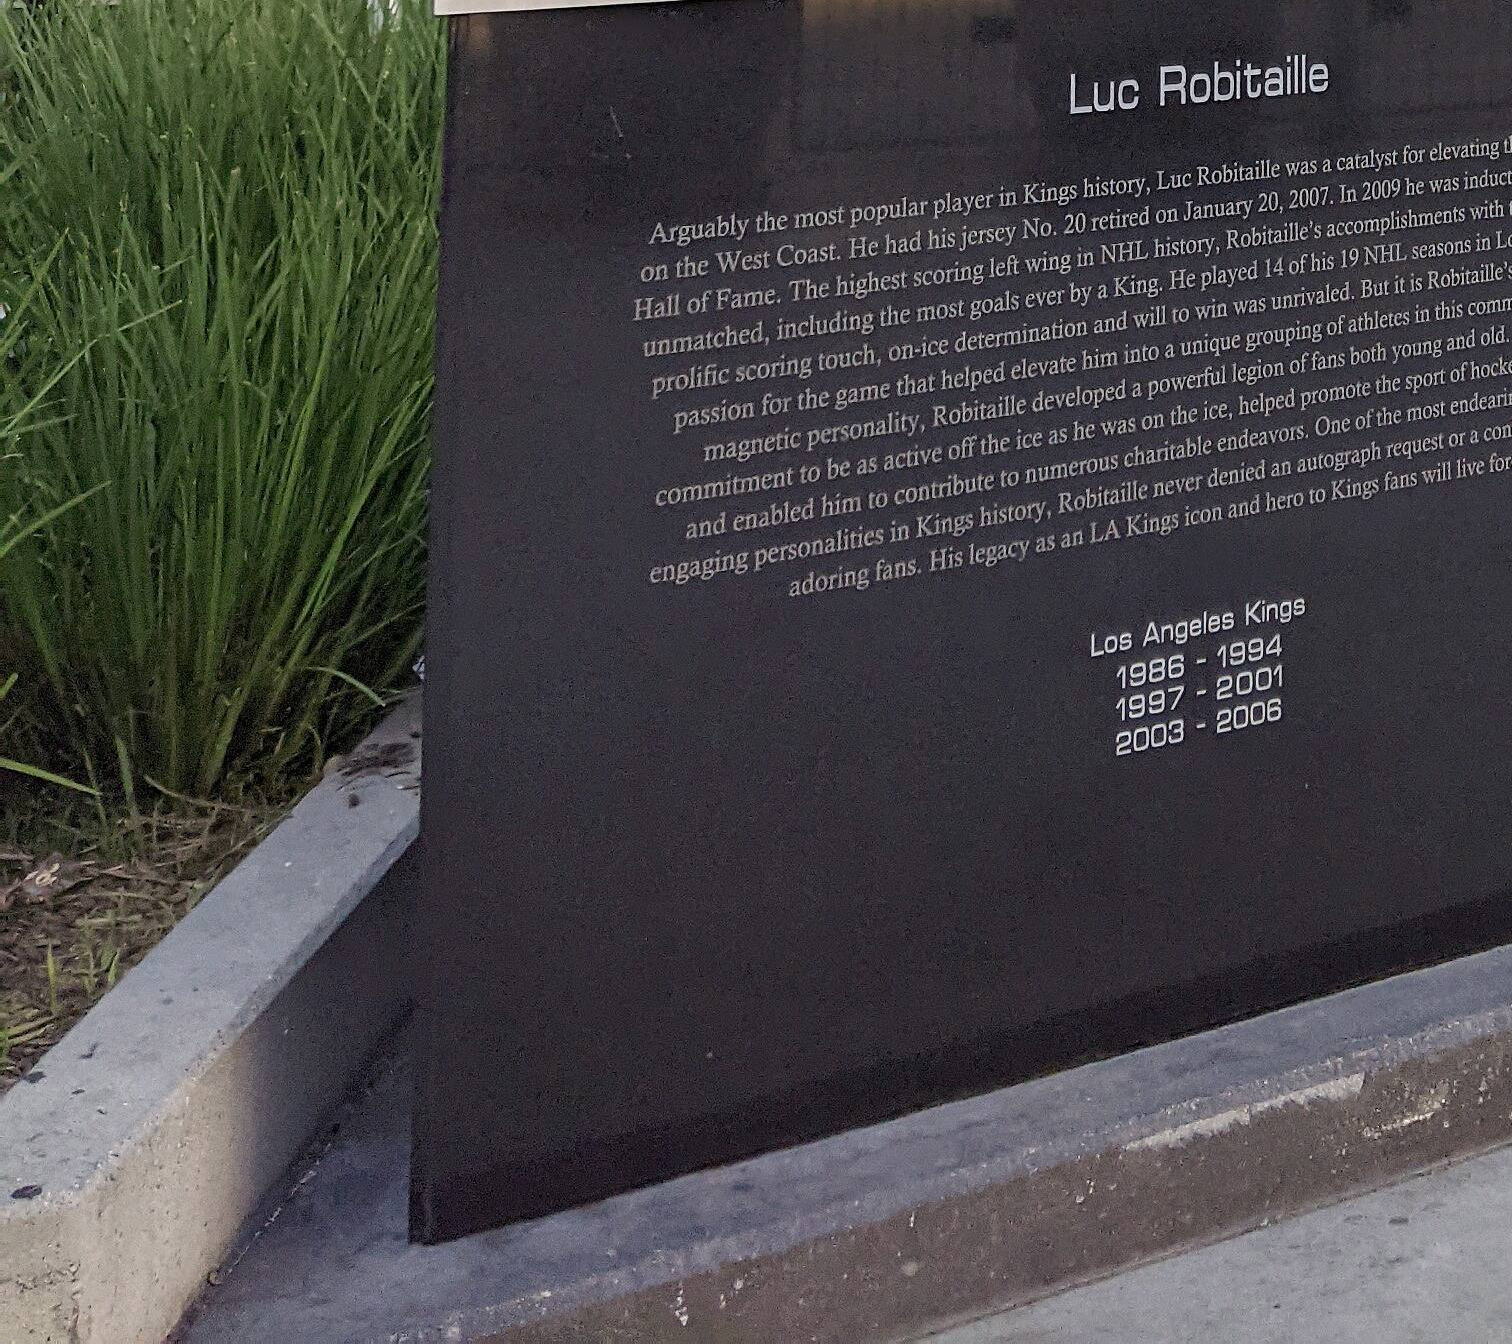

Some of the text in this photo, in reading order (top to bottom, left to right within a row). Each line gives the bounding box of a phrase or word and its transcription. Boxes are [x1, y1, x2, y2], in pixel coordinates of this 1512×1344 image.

[1071, 55, 1328, 114] Luc Robitaille
[648, 211, 750, 247] Arguably
[755, 210, 789, 233] the
[793, 205, 845, 229] most
[849, 196, 929, 229] popular
[932, 191, 994, 220] player
[998, 185, 1018, 207] in
[1022, 182, 1078, 206] Kings
[1082, 175, 1151, 198] history,
[1155, 169, 1193, 191] Luc
[1196, 158, 1281, 186] Robitaille
[1284, 159, 1318, 177] was
[1322, 158, 1333, 173] a
[1336, 148, 1399, 173] catalyst
[1401, 144, 1426, 165] for
[1429, 137, 1500, 162] elevating
[632, 292, 681, 322] Hall
[686, 289, 713, 315] of
[715, 287, 782, 311] Fame.
[788, 278, 830, 302] The
[834, 270, 909, 300] highest
[913, 260, 985, 288] scoring
[988, 254, 1020, 278] left
[1024, 250, 1072, 275] wing
[1076, 246, 1095, 268] in
[1100, 239, 1149, 265] NHL
[1153, 236, 1220, 259] history,
[1225, 219, 1322, 250] Robitaille's
[1326, 206, 1466, 238] accomplishments
[1469, 198, 1505, 221] with
[651, 363, 730, 400] prolific
[735, 353, 813, 383] scoring
[818, 342, 882, 371] touch,
[888, 335, 949, 362] on-ice
[954, 318, 1088, 353] determination
[1093, 309, 1129, 334] and
[1132, 304, 1167, 329] will
[1171, 307, 1190, 324] to
[1194, 297, 1228, 321] win
[1232, 297, 1267, 316] was
[1270, 281, 1355, 311] unrivaled.
[1360, 278, 1390, 299] But
[1393, 274, 1406, 294] it
[1410, 272, 1423, 293] is
[649, 549, 750, 585] engaging
[753, 525, 885, 572] personalities
[889, 519, 910, 543] in
[915, 512, 974, 539] Kings
[978, 501, 1052, 527] history,
[1057, 479, 1149, 515] Robitaille
[1152, 475, 1204, 498] never
[1207, 458, 1266, 488] denied
[1270, 460, 1292, 478] an
[1296, 440, 1382, 473] autograph
[1385, 432, 1445, 460] request
[1448, 431, 1466, 448] or
[1469, 429, 1480, 444] a
[685, 511, 727, 540] and
[732, 497, 815, 532] enabled
[821, 492, 862, 518] him
[868, 491, 889, 510] to
[893, 472, 994, 506] contribute
[999, 469, 1020, 488] to
[1024, 454, 1119, 484] numerous
[1124, 435, 1212, 468] charitable
[1217, 424, 1309, 453] endeavors.
[1314, 415, 1351, 437] One
[1354, 407, 1375, 431] of
[1376, 406, 1402, 427] the
[1406, 400, 1446, 423] most
[788, 565, 870, 597] adoring
[875, 558, 922, 582] fans.
[929, 546, 964, 572] His
[968, 539, 1030, 568] legacy
[1035, 534, 1056, 553] as
[1060, 529, 1084, 549] an
[1089, 519, 1121, 544] LA
[1125, 512, 1179, 538] Kings
[1184, 505, 1223, 527] icon
[1227, 493, 1261, 519] and
[1265, 491, 1305, 513] hero
[1308, 488, 1326, 505] to
[1330, 477, 1380, 501] Kings
[1384, 470, 1418, 492] fans
[1420, 460, 1452, 484] will
[1456, 457, 1485, 479] live
[1091, 598, 1305, 656] Los Angeles Kings
[1117, 655, 1184, 692] 1986
[1217, 634, 1282, 670] 1994
[1116, 684, 1184, 723] 1997
[1217, 663, 1282, 701] 2001
[1116, 717, 1184, 755] 2003
[1217, 696, 1281, 733] 2006
